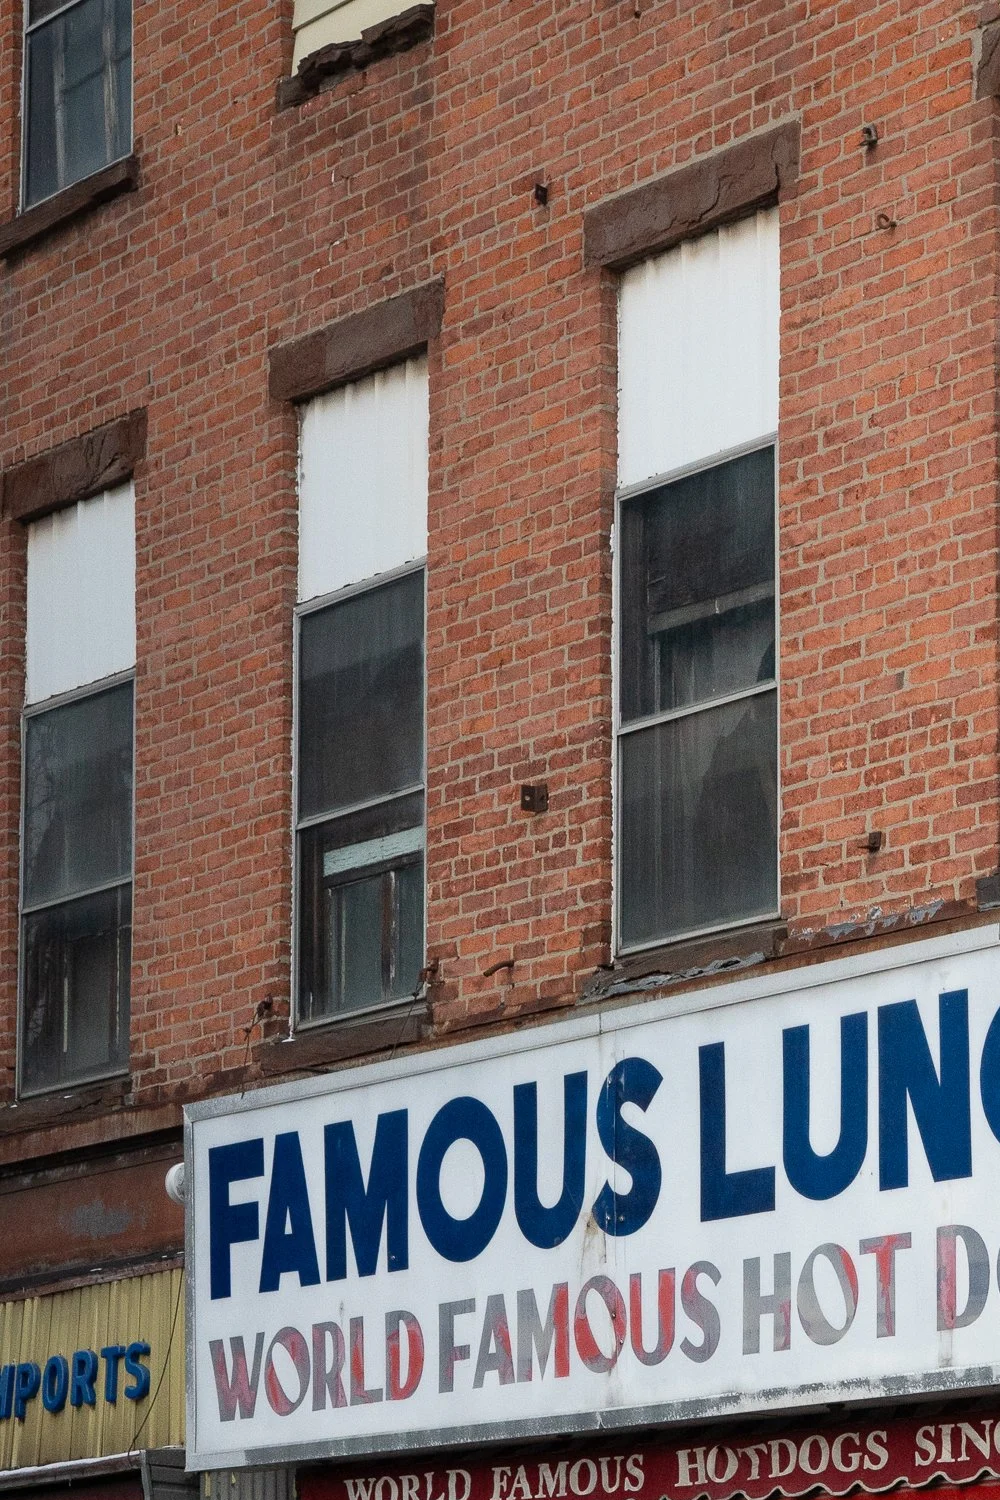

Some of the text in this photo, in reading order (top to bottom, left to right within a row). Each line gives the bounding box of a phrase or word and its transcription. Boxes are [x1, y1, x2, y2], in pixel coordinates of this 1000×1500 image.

[209, 1057, 663, 1300] FAMOUS
[209, 1309, 425, 1422] WORLD
[438, 1260, 721, 1394] FAMOUS
[742, 1232, 912, 1356] HOT
[675, 1430, 889, 1487] HOTDOGS
